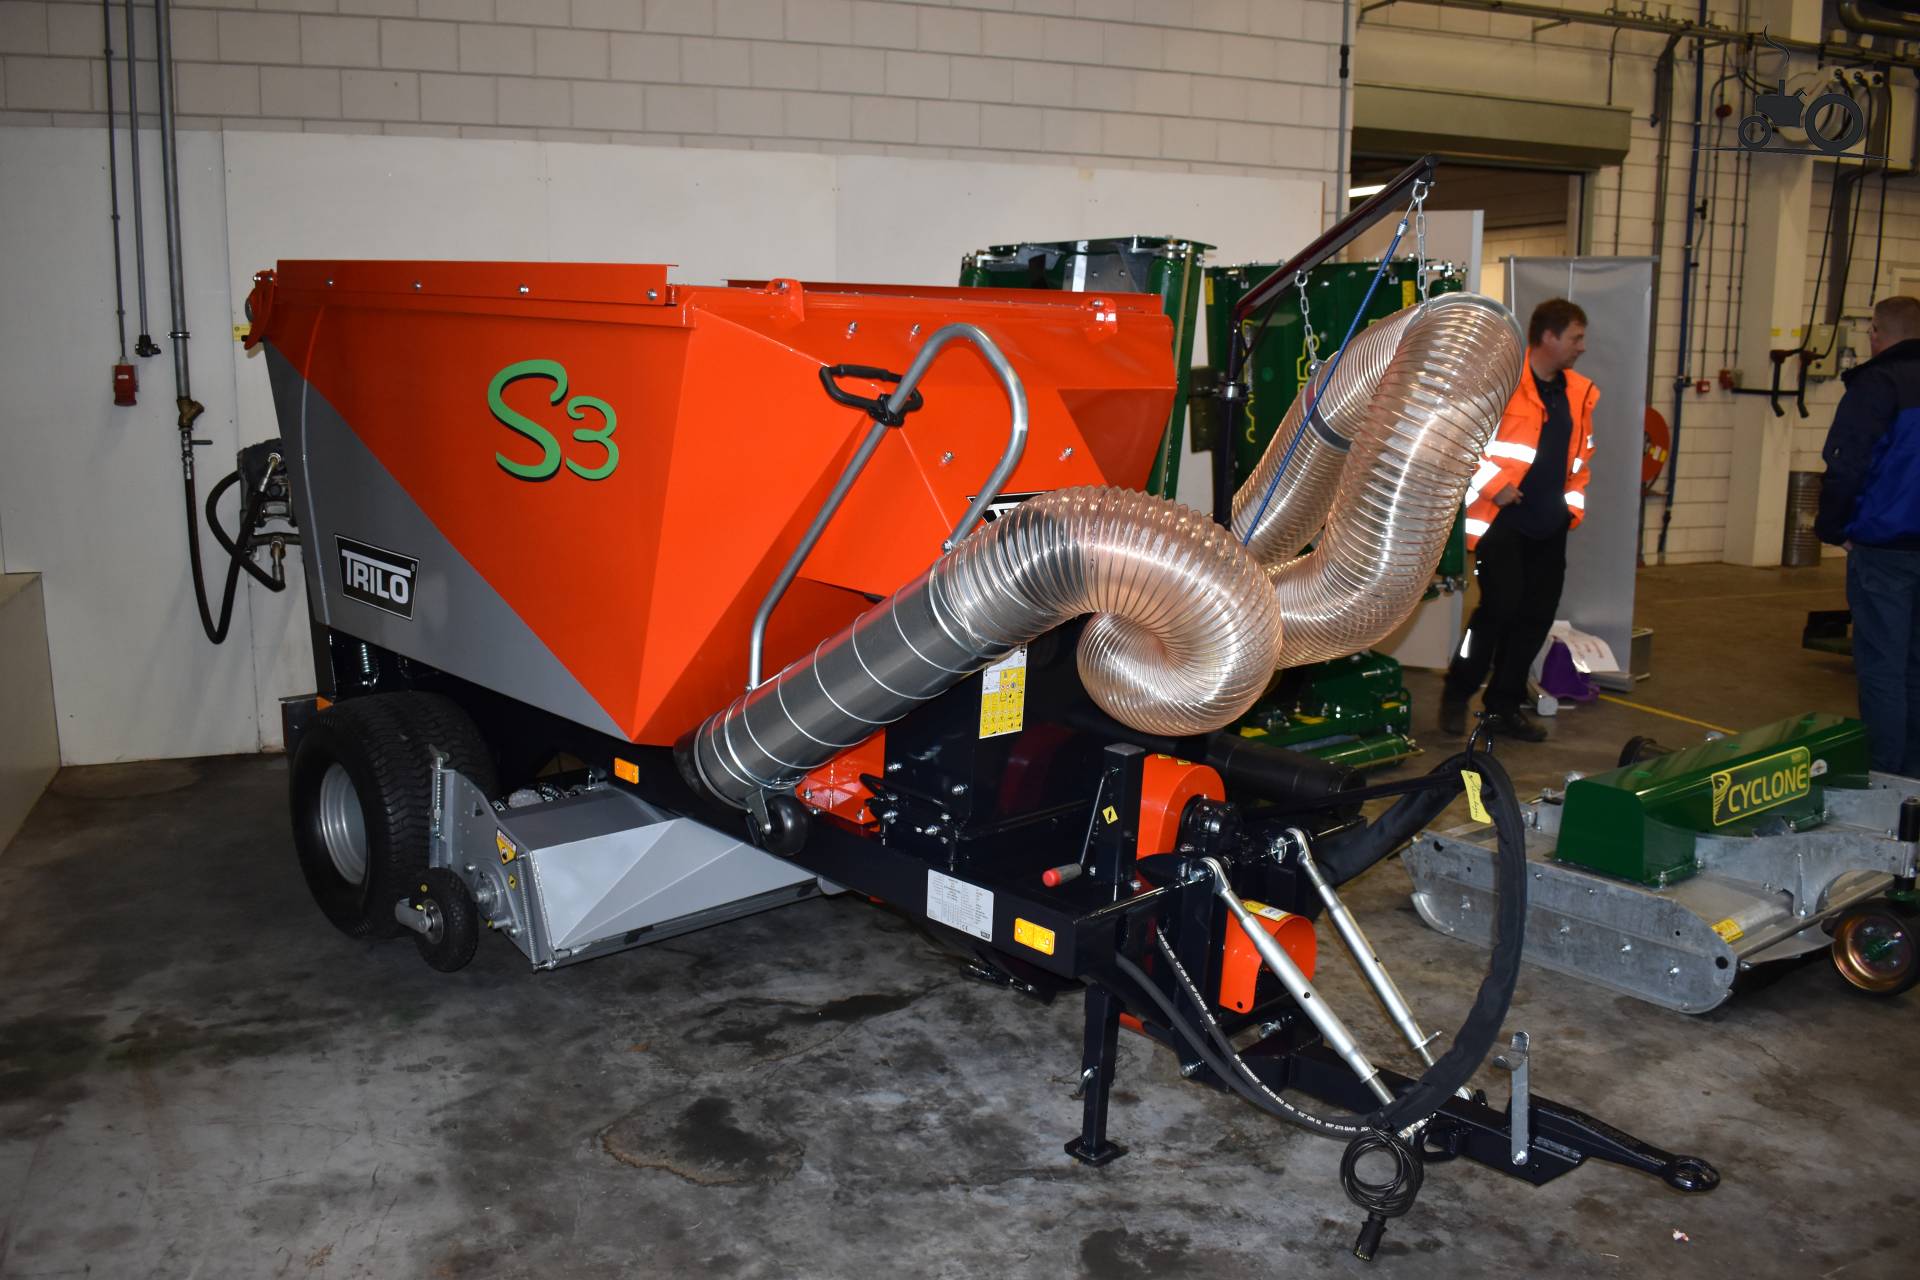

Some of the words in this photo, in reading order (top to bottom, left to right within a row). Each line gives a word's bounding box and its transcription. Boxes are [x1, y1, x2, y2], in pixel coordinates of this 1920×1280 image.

[488, 359, 619, 482] S3
[341, 548, 411, 604] TRILO
[1728, 764, 1808, 813] CYCLONE
